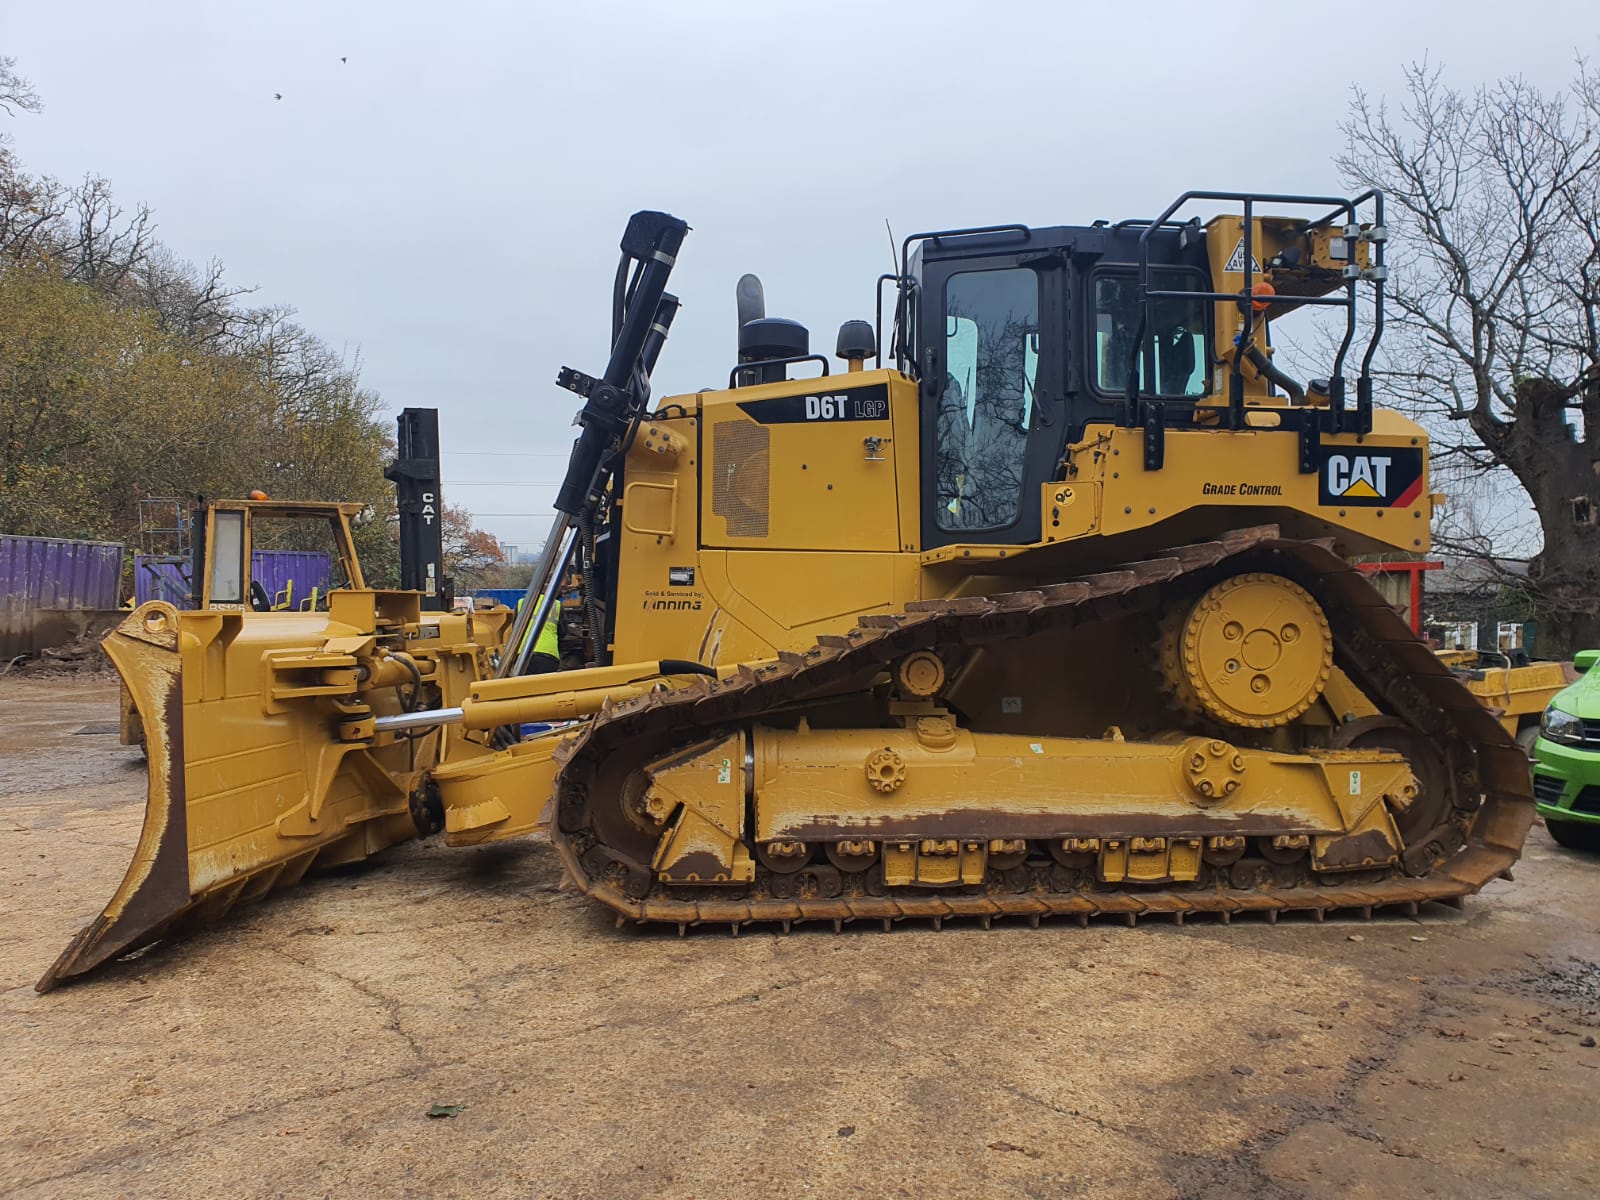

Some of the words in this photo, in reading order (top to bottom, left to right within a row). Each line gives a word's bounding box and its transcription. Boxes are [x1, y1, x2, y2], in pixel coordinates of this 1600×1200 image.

[805, 395, 848, 419] D6T
[854, 400, 886, 418] LGP
[1202, 482, 1237, 495] GRADE
[1239, 482, 1283, 496] CONTROL
[1328, 454, 1392, 498] CAT
[422, 492, 435, 525] CAT
